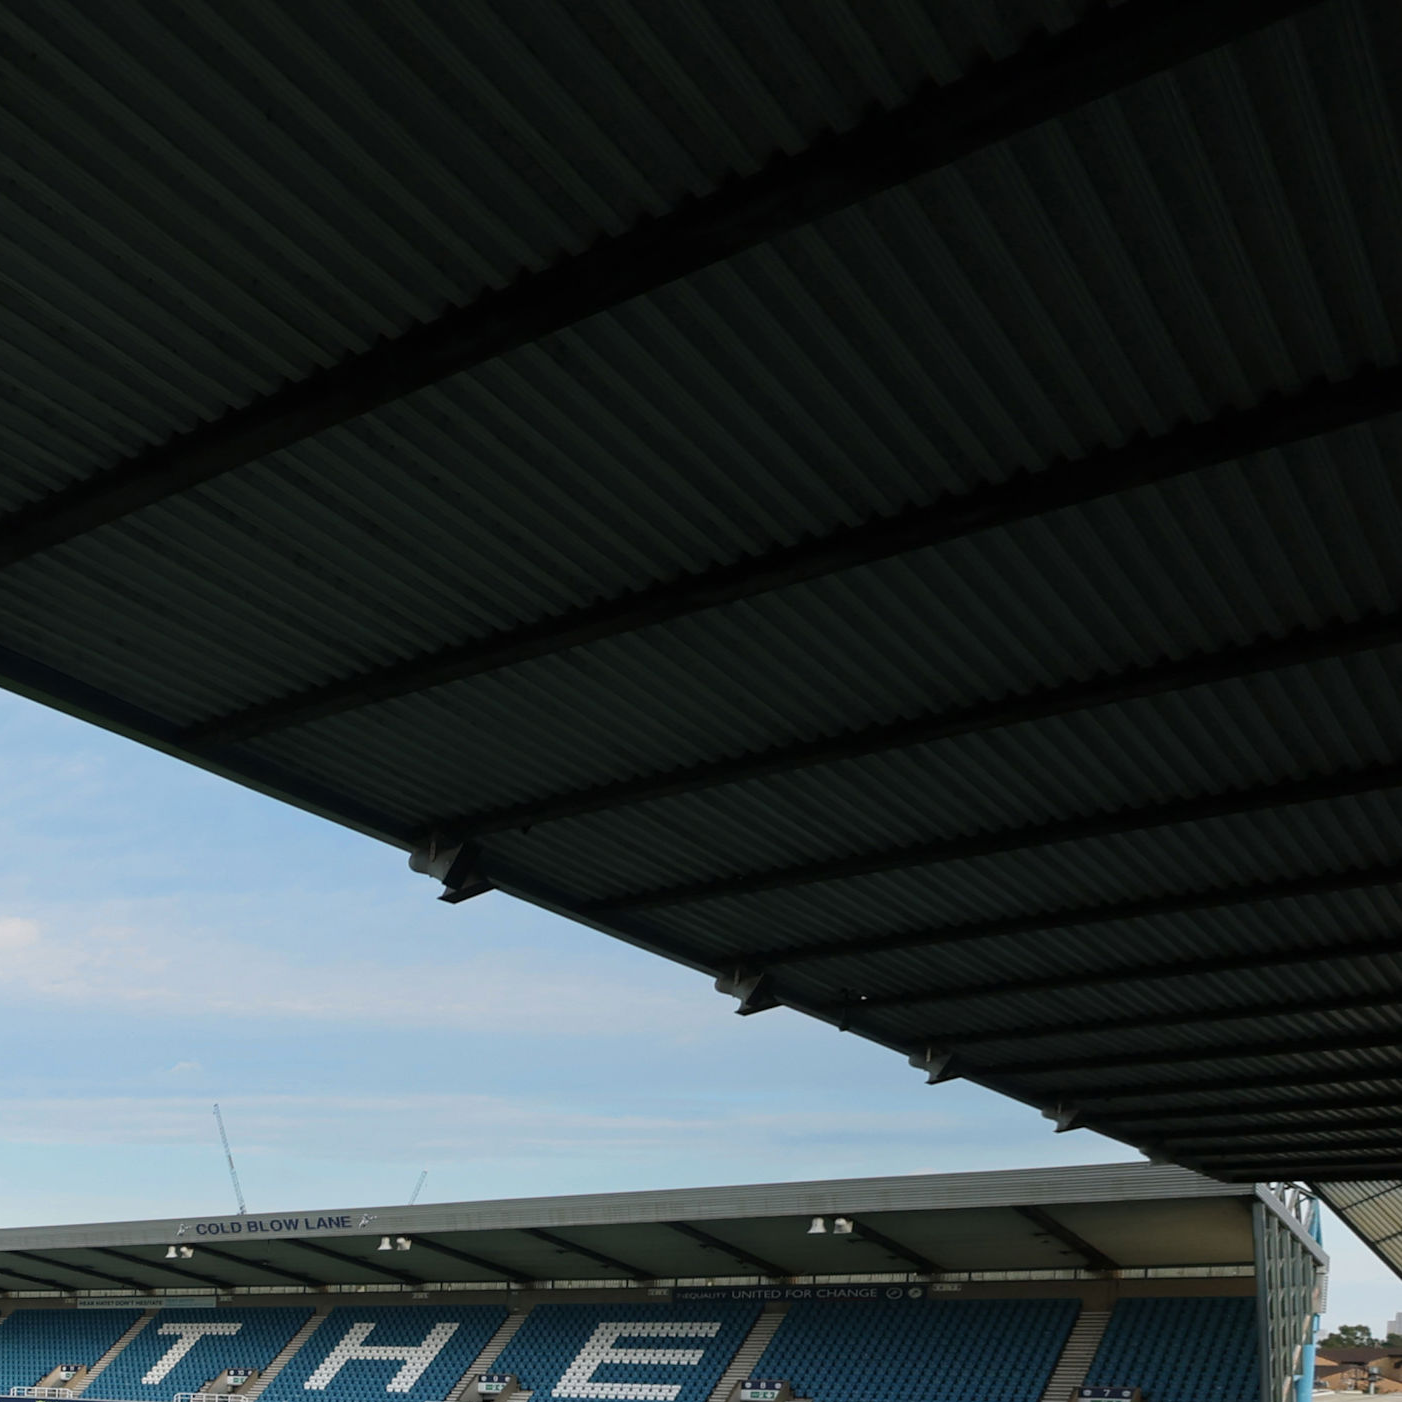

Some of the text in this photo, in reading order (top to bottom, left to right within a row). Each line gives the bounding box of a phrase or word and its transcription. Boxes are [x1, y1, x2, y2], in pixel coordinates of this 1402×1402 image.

[196, 1216, 352, 1235] COLD BLOW LANE
[732, 1288, 877, 1300] UNITED FOR CHANGE
[141, 1321, 722, 1402] THE
